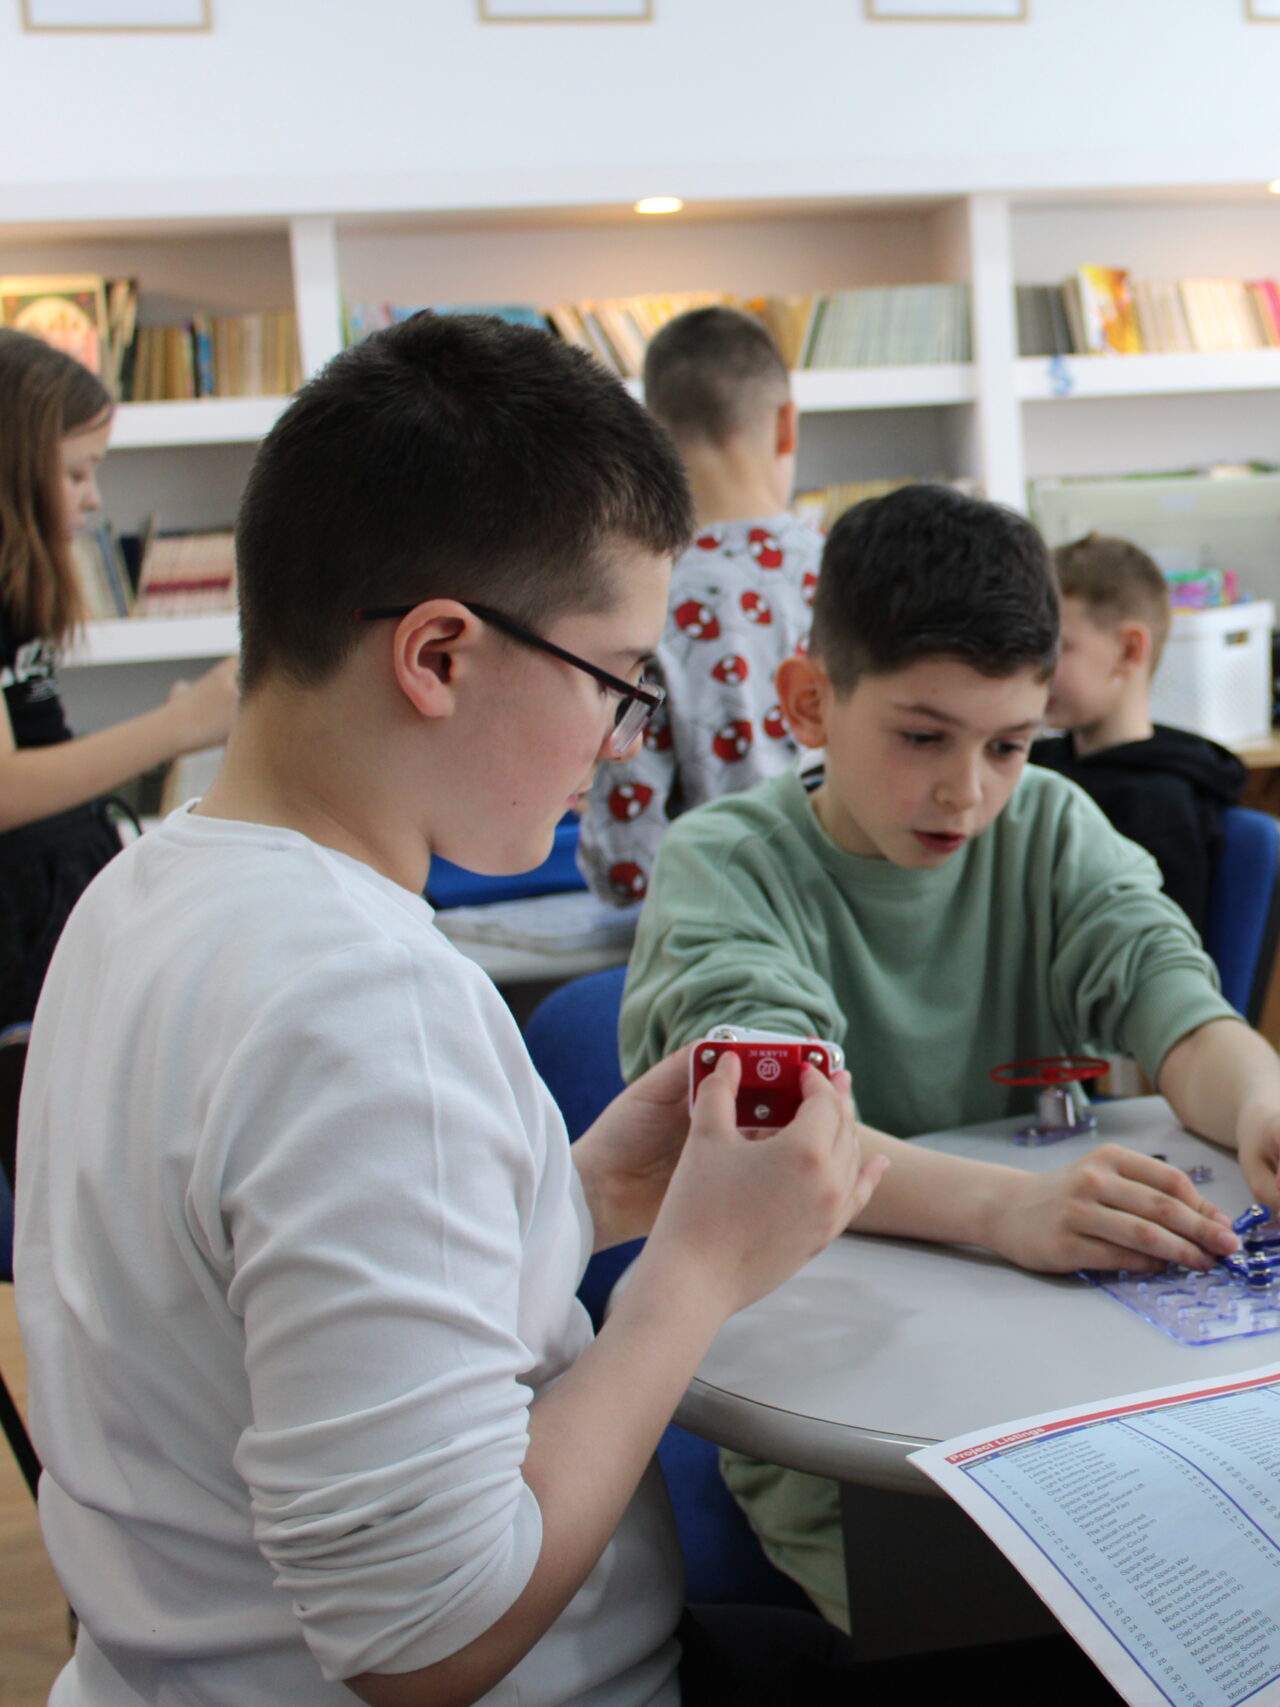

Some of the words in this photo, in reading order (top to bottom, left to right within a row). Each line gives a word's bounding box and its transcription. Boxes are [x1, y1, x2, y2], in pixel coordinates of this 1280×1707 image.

[950, 1442, 994, 1462] Project
[995, 1427, 1046, 1446] Listings
[1119, 1561, 1142, 1576] Space
[1140, 1552, 1156, 1563] War
[1126, 1571, 1145, 1584] Light
[1143, 1558, 1167, 1574] Switch
[1133, 1577, 1154, 1592] Paper
[1153, 1564, 1177, 1580] Space
[1175, 1556, 1189, 1567] War
[1140, 1586, 1159, 1600] Light
[1157, 1575, 1179, 1589] Police
[1178, 1564, 1197, 1577] Siren
[1147, 1594, 1166, 1607] More
[1165, 1583, 1184, 1597] Loud
[1183, 1569, 1210, 1586] Sounds
[1154, 1602, 1173, 1616] More
[1172, 1591, 1192, 1605] Loud
[1190, 1576, 1217, 1594] Sounds
[1161, 1610, 1181, 1624] More
[1179, 1599, 1199, 1613] Loud
[1197, 1584, 1224, 1602] Sounds
[1168, 1618, 1188, 1632] More
[1186, 1606, 1206, 1621] Loud
[1204, 1592, 1231, 1610] Sounds
[1176, 1627, 1194, 1641] Clap
[1192, 1612, 1220, 1631] Sounds
[1183, 1635, 1202, 1649] More
[1201, 1624, 1219, 1637] Clap
[1217, 1608, 1245, 1627] Sounds
[1189, 1643, 1210, 1657] More
[1208, 1632, 1226, 1646] Clap
[1224, 1616, 1252, 1635] Sounds
[1197, 1652, 1217, 1666] More
[1216, 1641, 1234, 1655] Clap
[1232, 1625, 1260, 1644] Sounds
[1204, 1661, 1224, 1675] More
[1223, 1649, 1241, 1663] Clap
[1239, 1633, 1267, 1652] Sounds
[1212, 1668, 1233, 1683] Voice
[1231, 1656, 1251, 1671] Light
[1248, 1644, 1270, 1660] Diode
[1219, 1677, 1240, 1692] Voice
[1239, 1660, 1265, 1680] Control
[1226, 1685, 1248, 1700] Motor
[1247, 1670, 1271, 1688] Space
